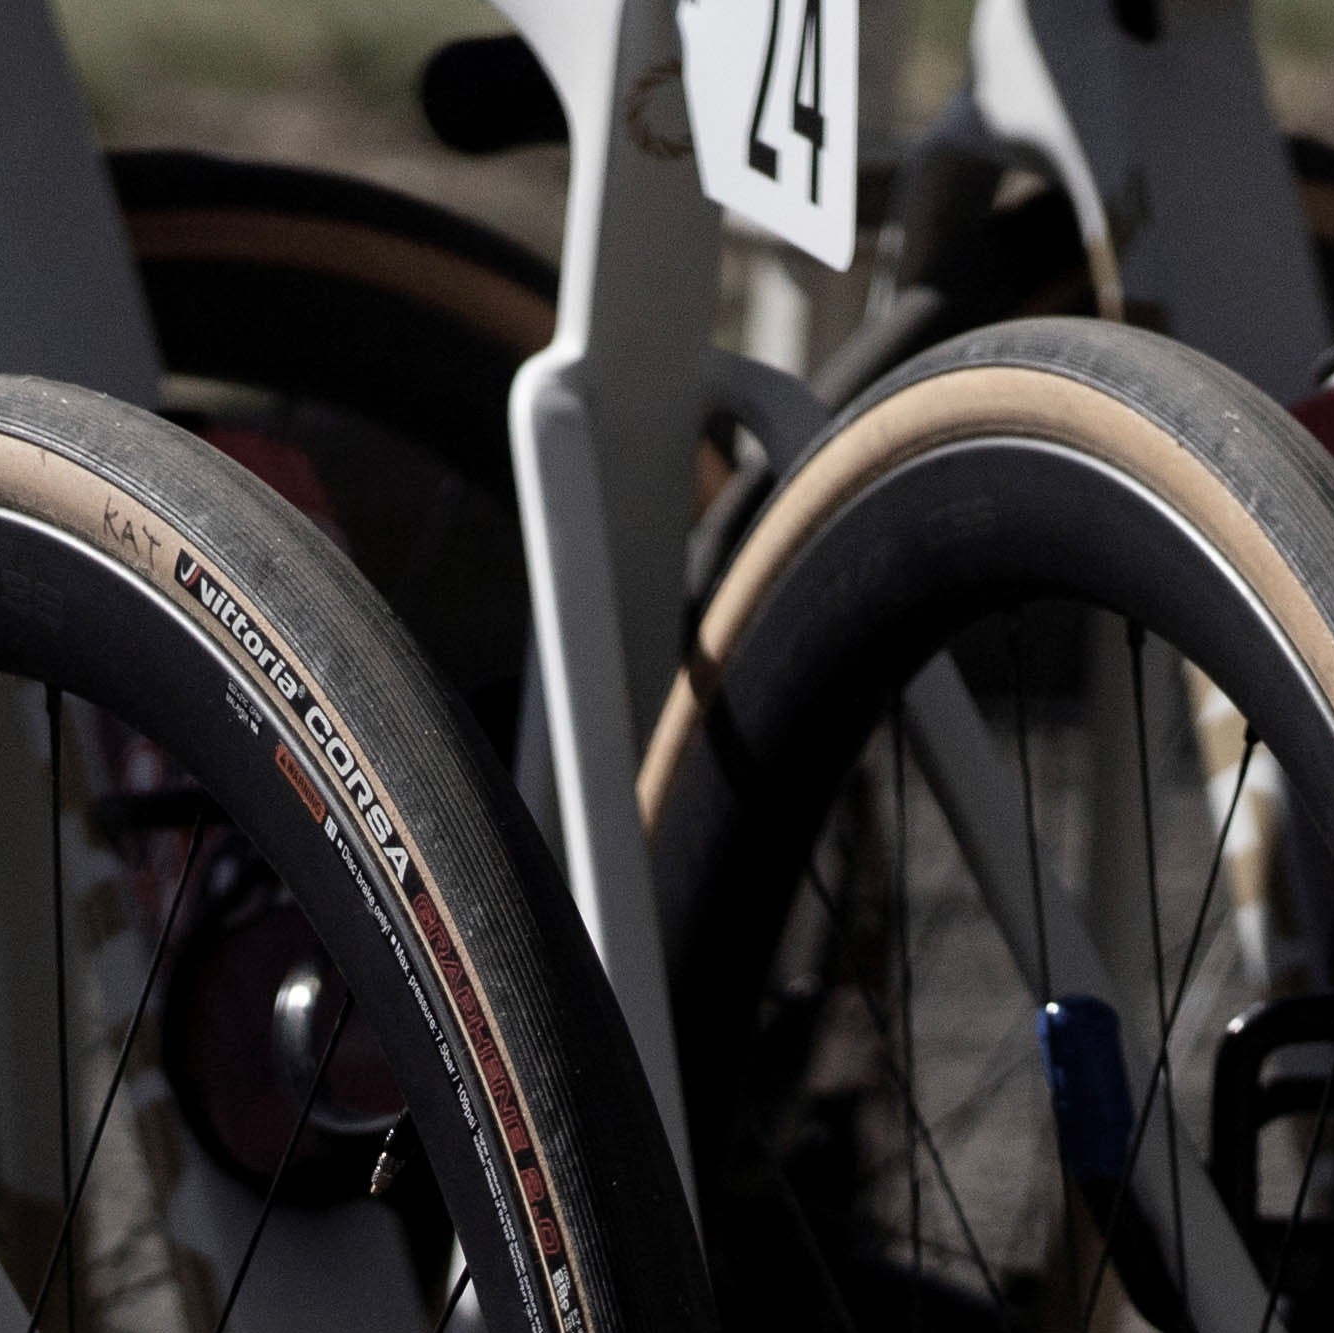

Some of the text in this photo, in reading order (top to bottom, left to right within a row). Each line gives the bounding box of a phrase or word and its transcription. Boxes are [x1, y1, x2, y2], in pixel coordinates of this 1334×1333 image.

[748, 0, 824, 205] 24
[304, 705, 409, 884] CORSA
[412, 892, 530, 1153] GRAPHENE
[520, 1167, 561, 1255] 2.0
